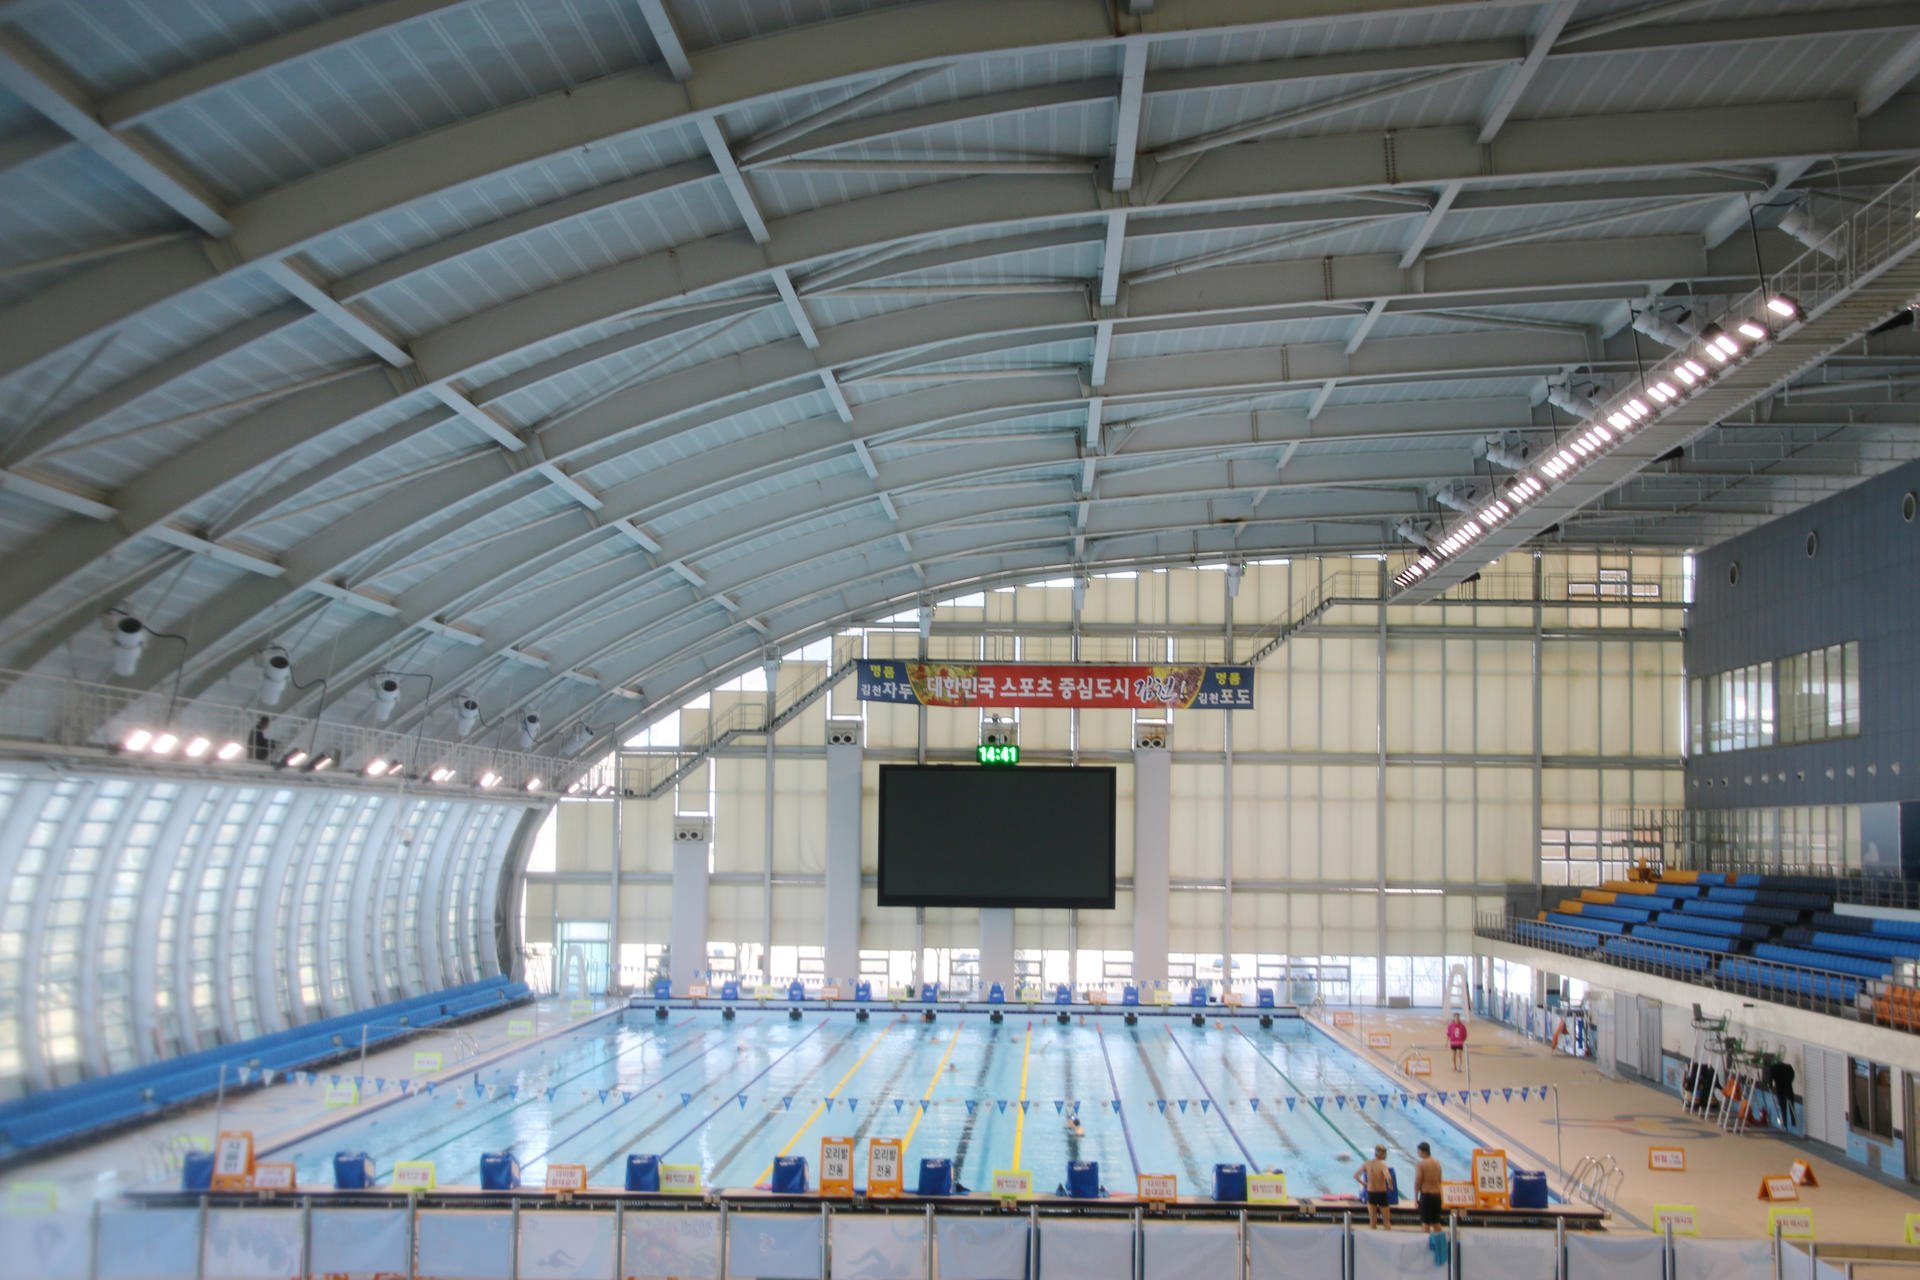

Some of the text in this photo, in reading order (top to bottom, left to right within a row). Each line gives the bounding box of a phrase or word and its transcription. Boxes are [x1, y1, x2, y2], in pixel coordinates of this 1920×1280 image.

[870, 665, 895, 679] 명품
[1215, 672, 1241, 685] 명품
[926, 677, 996, 699] 대한민국
[1000, 677, 1053, 697] 스포츠
[1058, 677, 1129, 700] 중심도시
[979, 746, 1016, 762] 14:41
[825, 1148, 848, 1160] 오리발
[873, 1148, 896, 1161] 오리발
[828, 1164, 843, 1176] 전용
[877, 1165, 891, 1177] 전용
[1483, 1160, 1498, 1171] 선수
[1480, 1177, 1504, 1189] 훈련중
